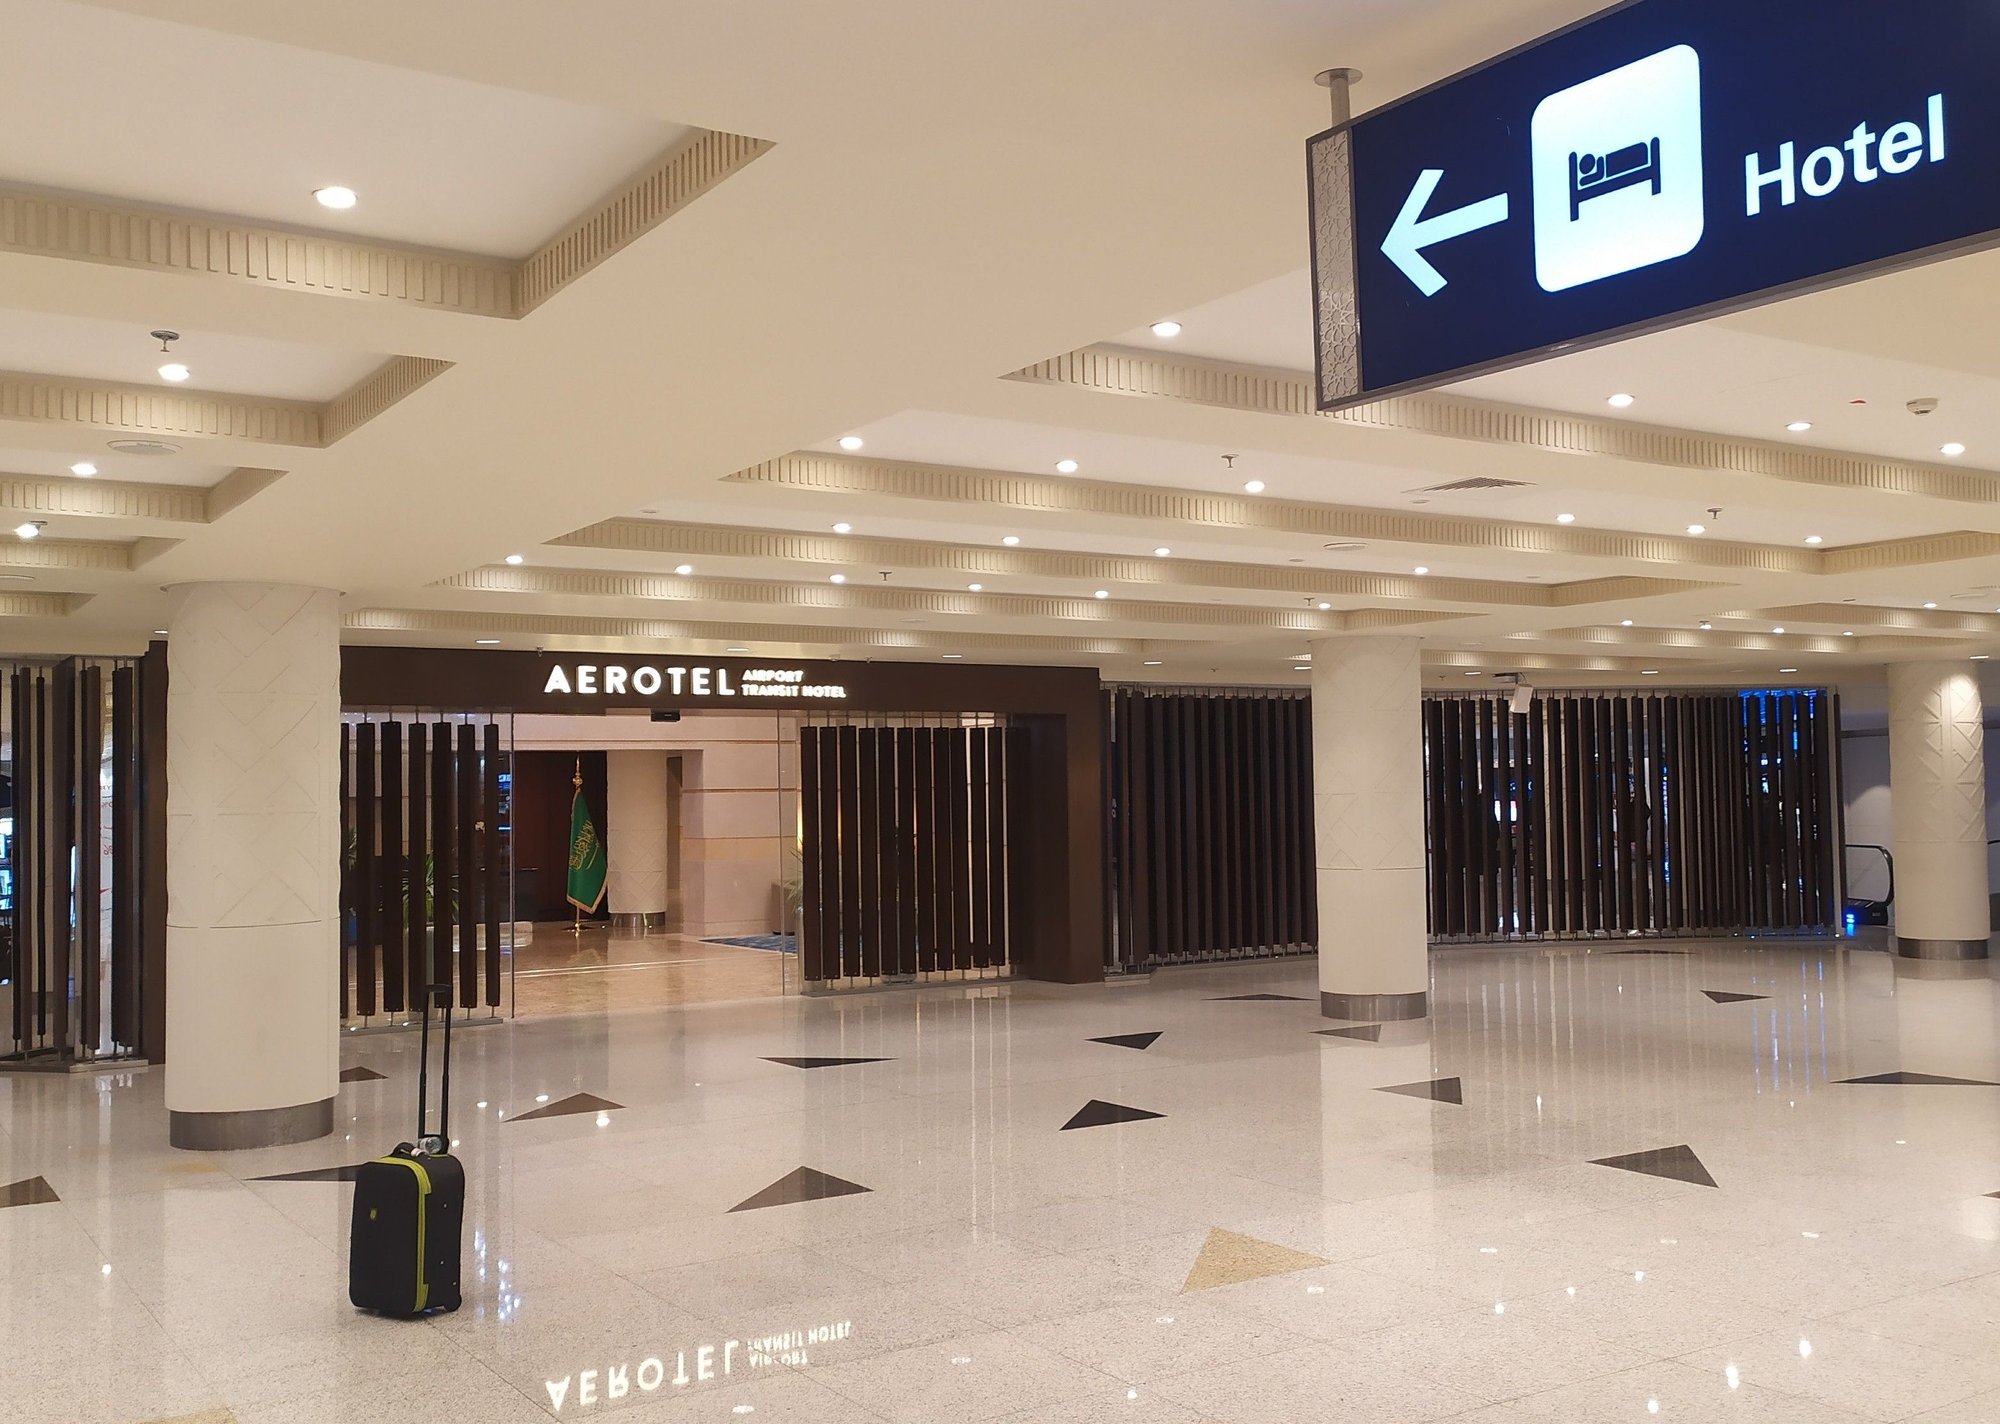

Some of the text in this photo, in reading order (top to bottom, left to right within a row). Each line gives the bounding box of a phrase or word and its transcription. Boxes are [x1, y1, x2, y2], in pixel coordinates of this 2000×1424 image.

[1745, 93, 1945, 216] Hotel
[543, 665, 735, 696] AEROTEL
[742, 669, 804, 682] AIRPORT
[741, 684, 847, 698] TRANSIT HOTEL
